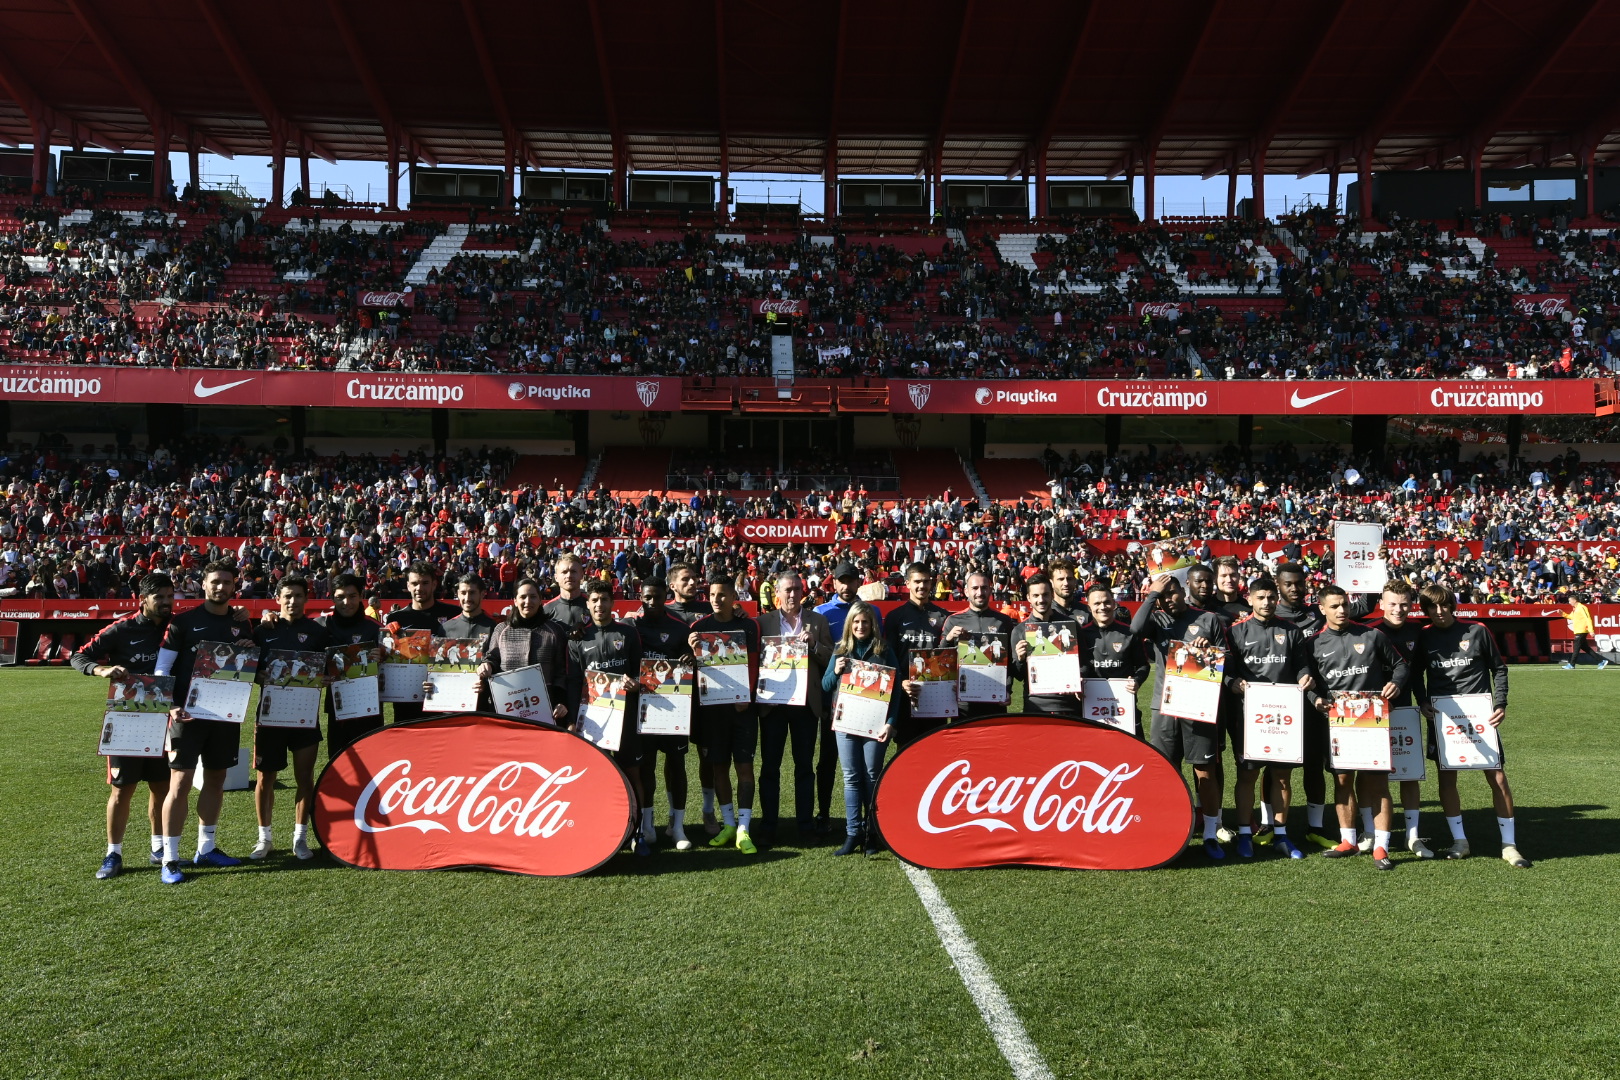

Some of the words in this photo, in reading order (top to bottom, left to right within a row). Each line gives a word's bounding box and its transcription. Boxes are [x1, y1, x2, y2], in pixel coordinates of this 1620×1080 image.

[0, 376, 101, 397] uzcampo
[346, 378, 464, 404] Cruzcampo
[528, 384, 591, 400] Playtika
[996, 389, 1057, 405] Playtika
[1097, 387, 1207, 410] Cruzcampo
[1430, 387, 1543, 410] Cruzcampo
[744, 525, 828, 538] CORDIALITY
[0, 610, 40, 619] ruzcampo
[594, 658, 627, 670] betfair
[1094, 659, 1124, 668] betfair
[1254, 654, 1287, 664] betfair
[1438, 657, 1474, 668] betfair
[1334, 664, 1370, 678] betfair
[354, 759, 588, 839] Coca-Cola
[917, 759, 1144, 834] Coca-Cola
